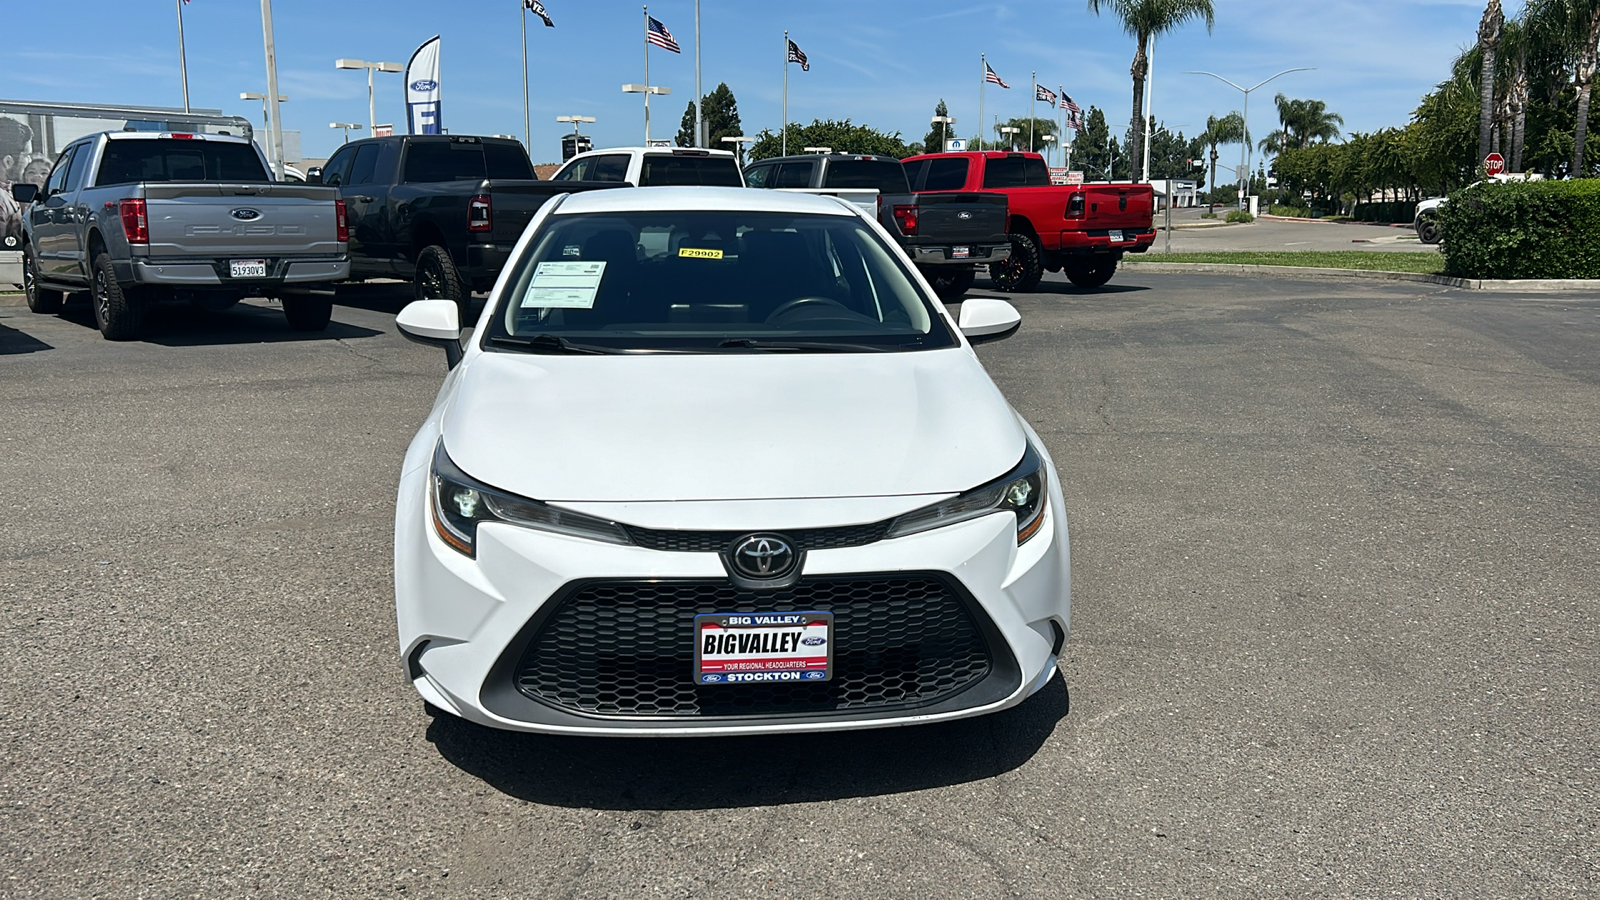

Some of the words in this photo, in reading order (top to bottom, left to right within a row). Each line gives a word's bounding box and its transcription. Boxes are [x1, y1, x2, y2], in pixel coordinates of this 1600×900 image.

[415, 81, 435, 91] Ford
[412, 103, 436, 135] F
[1485, 160, 1503, 169] STOP
[184, 224, 306, 236] F-150
[681, 249, 720, 258] F29902
[232, 266, 265, 276] 51930V3
[729, 616, 752, 625] BIG
[755, 615, 800, 625] VALLEY
[703, 631, 802, 655] BIGVALLEY
[804, 636, 823, 646] Ford
[724, 663, 739, 671] YOUR
[740, 662, 765, 670] REGIONAL
[766, 660, 807, 669] HEADQUARTERS
[727, 671, 801, 682] STOCKTON
